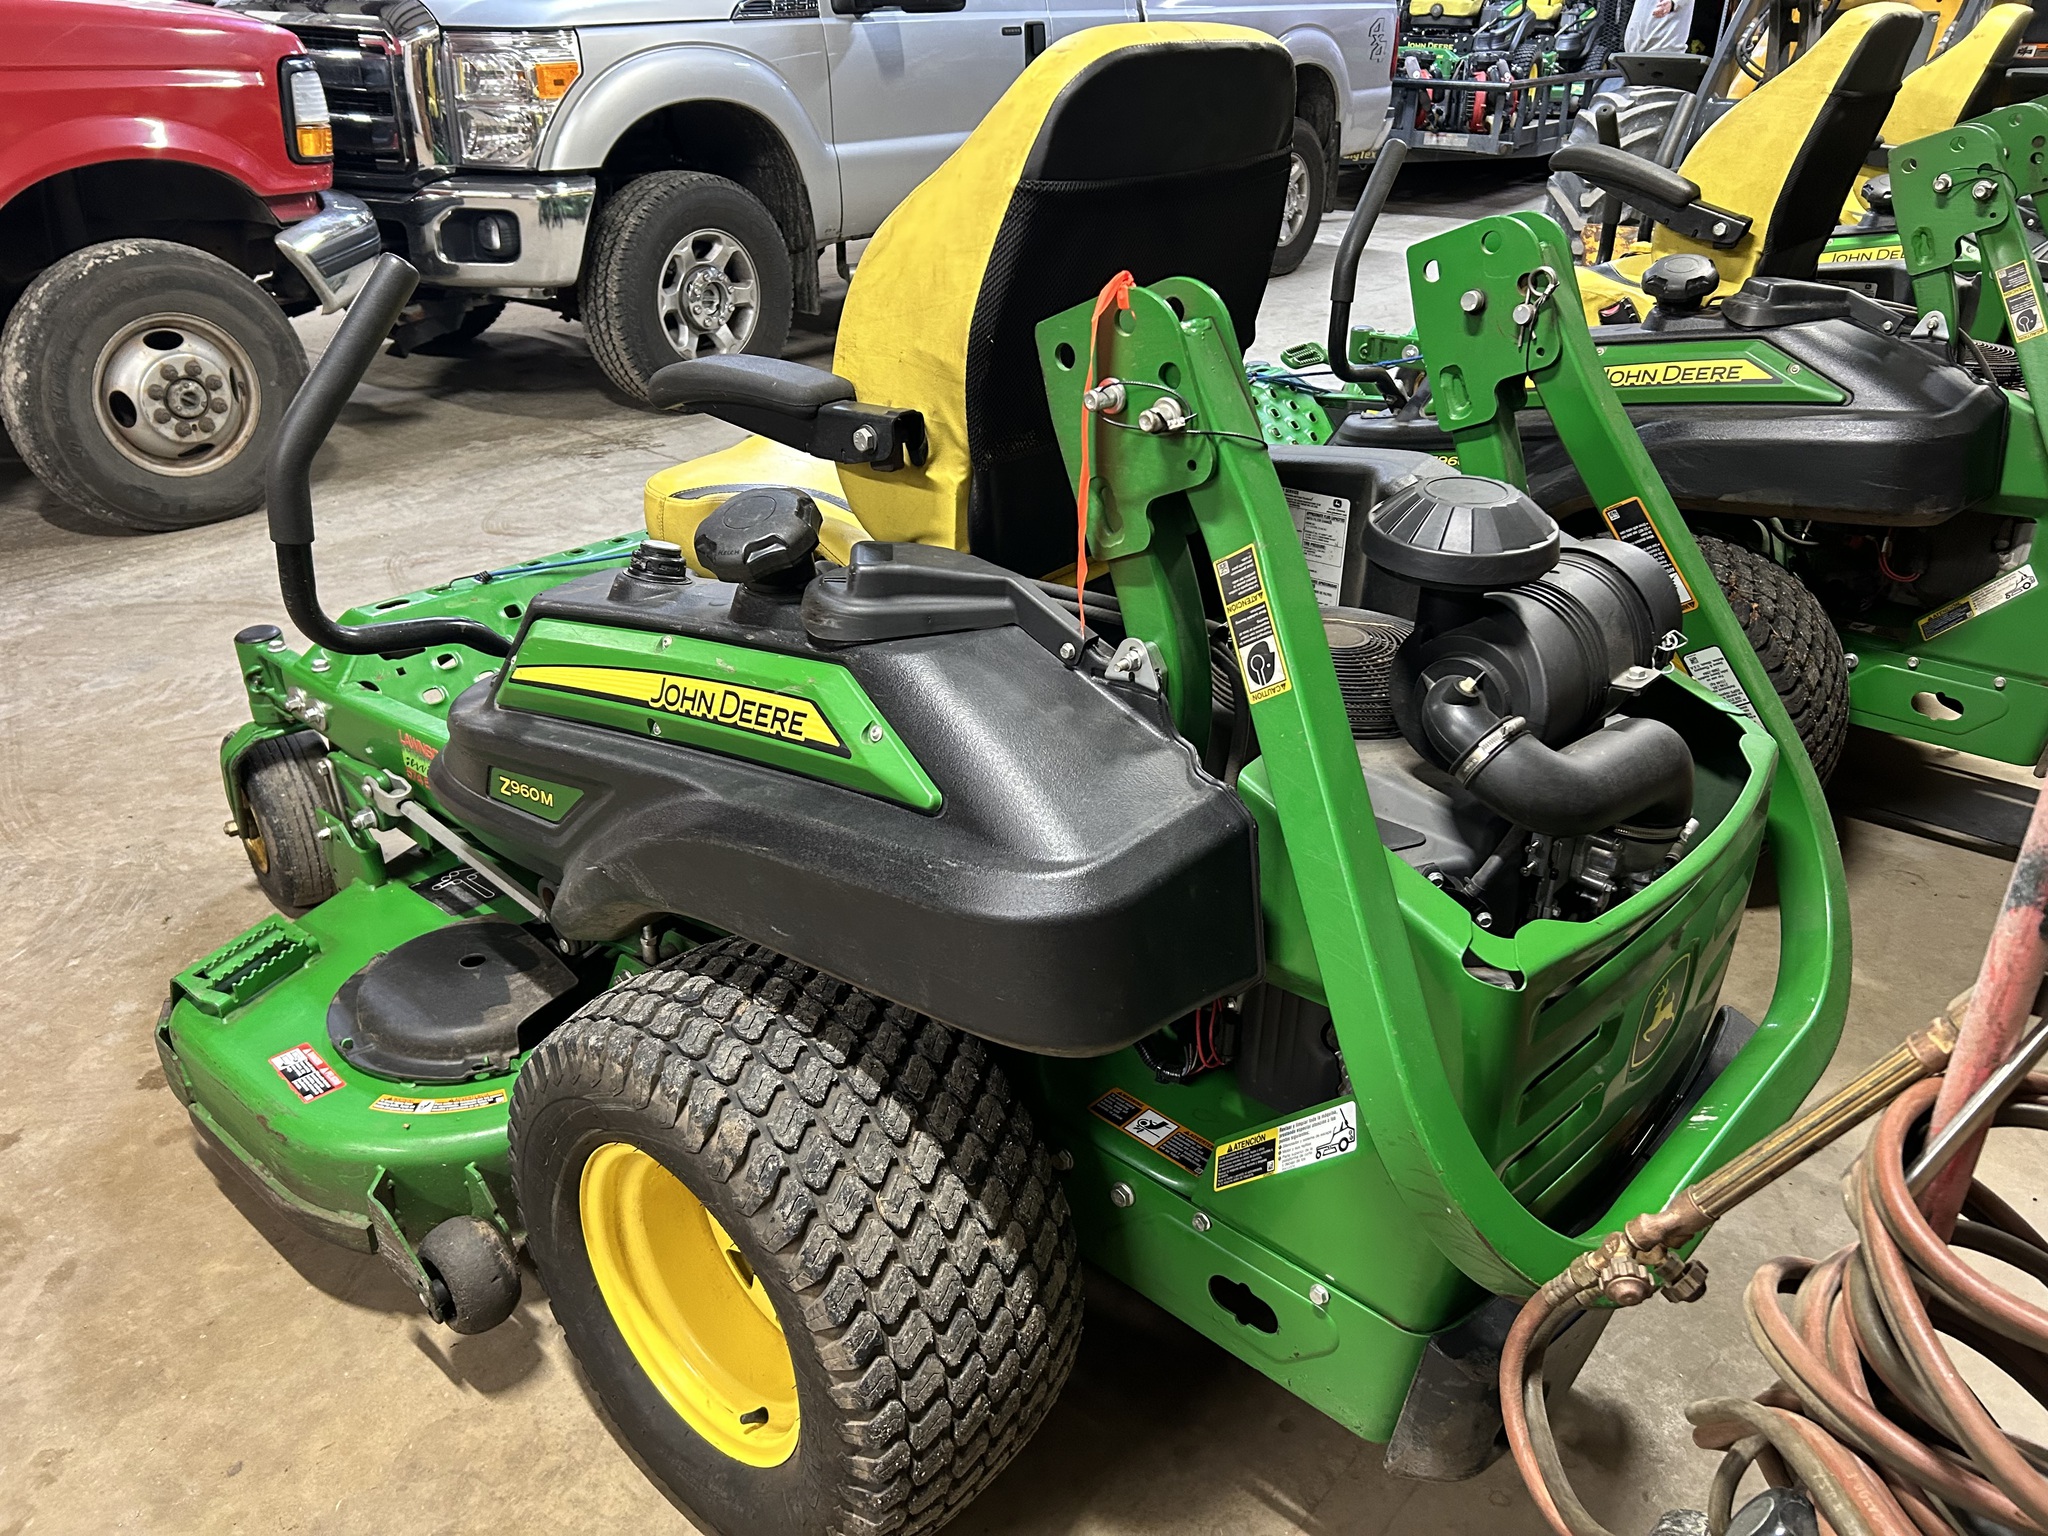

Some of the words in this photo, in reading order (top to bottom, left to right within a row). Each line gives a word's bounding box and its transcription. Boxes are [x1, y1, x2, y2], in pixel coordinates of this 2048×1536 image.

[1428, 41, 1454, 50] DEERE
[1832, 252, 1873, 263] JOHN
[1876, 248, 1905, 261] DE
[1662, 365, 1743, 383] DEERE
[1226, 595, 1258, 613] ATENCIÓN
[1252, 686, 1282, 701] CAUTION
[650, 677, 716, 715] JOHN
[719, 690, 808, 736] DEERE
[499, 775, 554, 808] Z960M
[1233, 1133, 1267, 1151] ATENCIÓN
